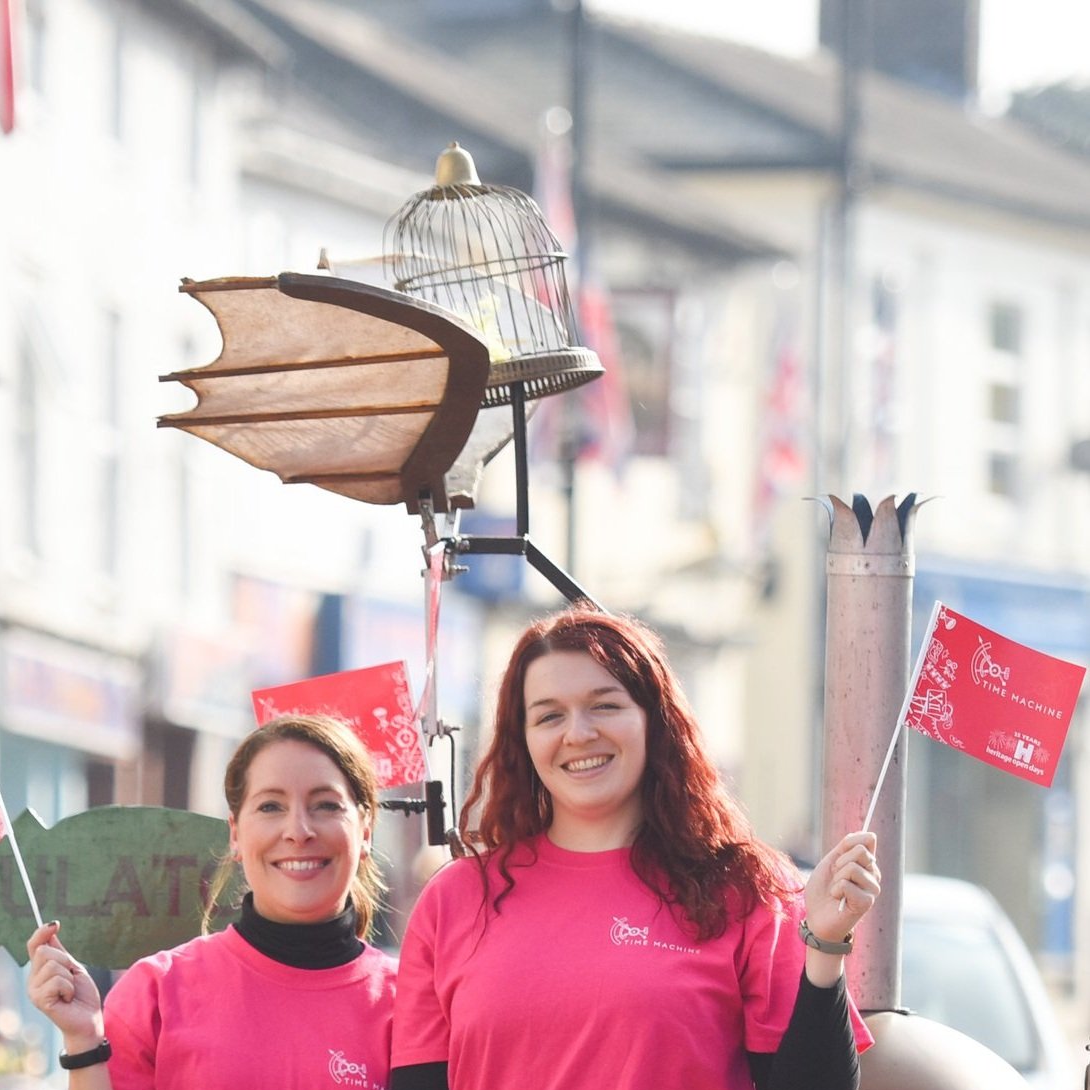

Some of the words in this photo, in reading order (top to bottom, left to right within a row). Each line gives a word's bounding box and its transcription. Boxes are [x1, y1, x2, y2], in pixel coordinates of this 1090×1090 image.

[982, 680, 1007, 697] TIME
[1011, 693, 1063, 719] MACHINE
[1022, 734, 1042, 747] YEARS
[986, 745, 1012, 763] heritage
[1012, 758, 1029, 770] open
[1028, 763, 1045, 776] days
[653, 940, 701, 955] MACHINE
[344, 1077, 368, 1089] TIME
